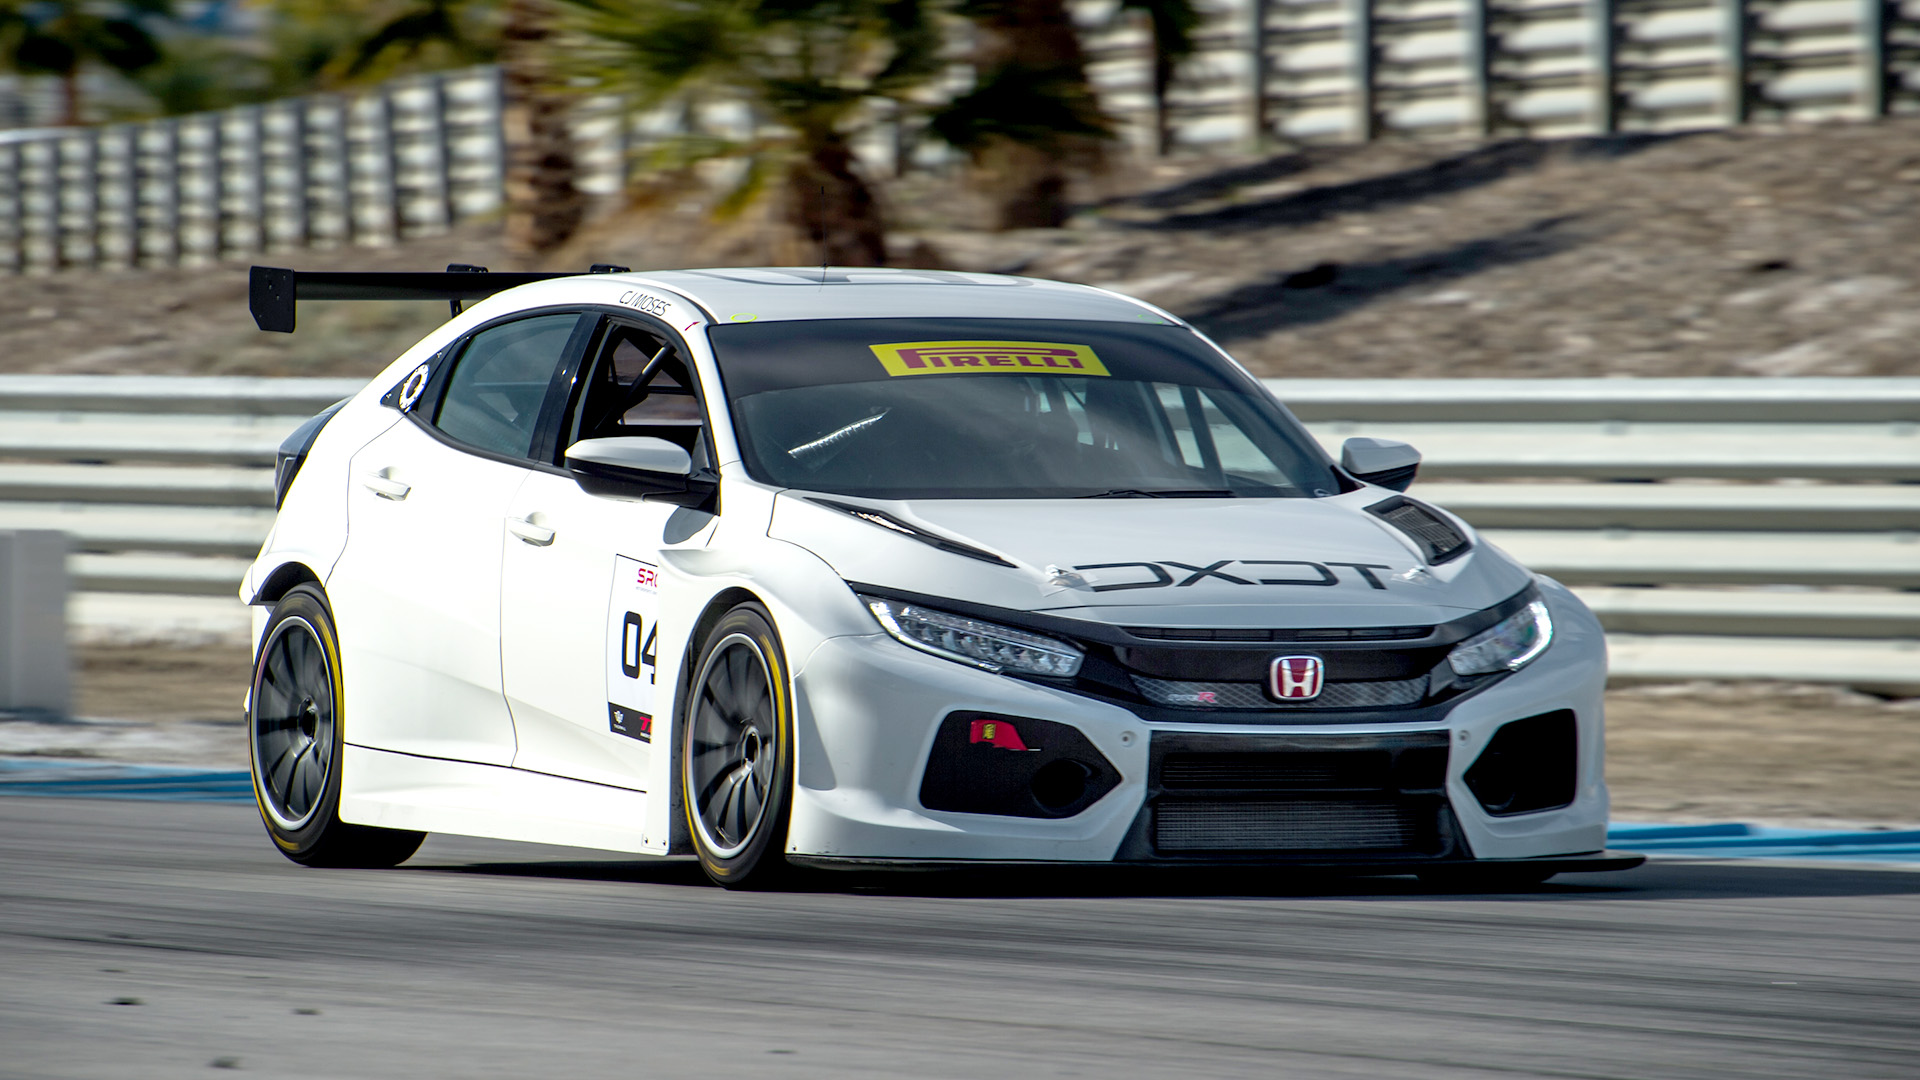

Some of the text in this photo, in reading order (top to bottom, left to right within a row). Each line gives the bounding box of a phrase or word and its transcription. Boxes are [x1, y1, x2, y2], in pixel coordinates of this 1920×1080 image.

[619, 291, 671, 316] CJ MOSES
[895, 347, 1085, 369] PIRELLI
[637, 568, 658, 588] SR
[1072, 560, 1392, 592] DXDT
